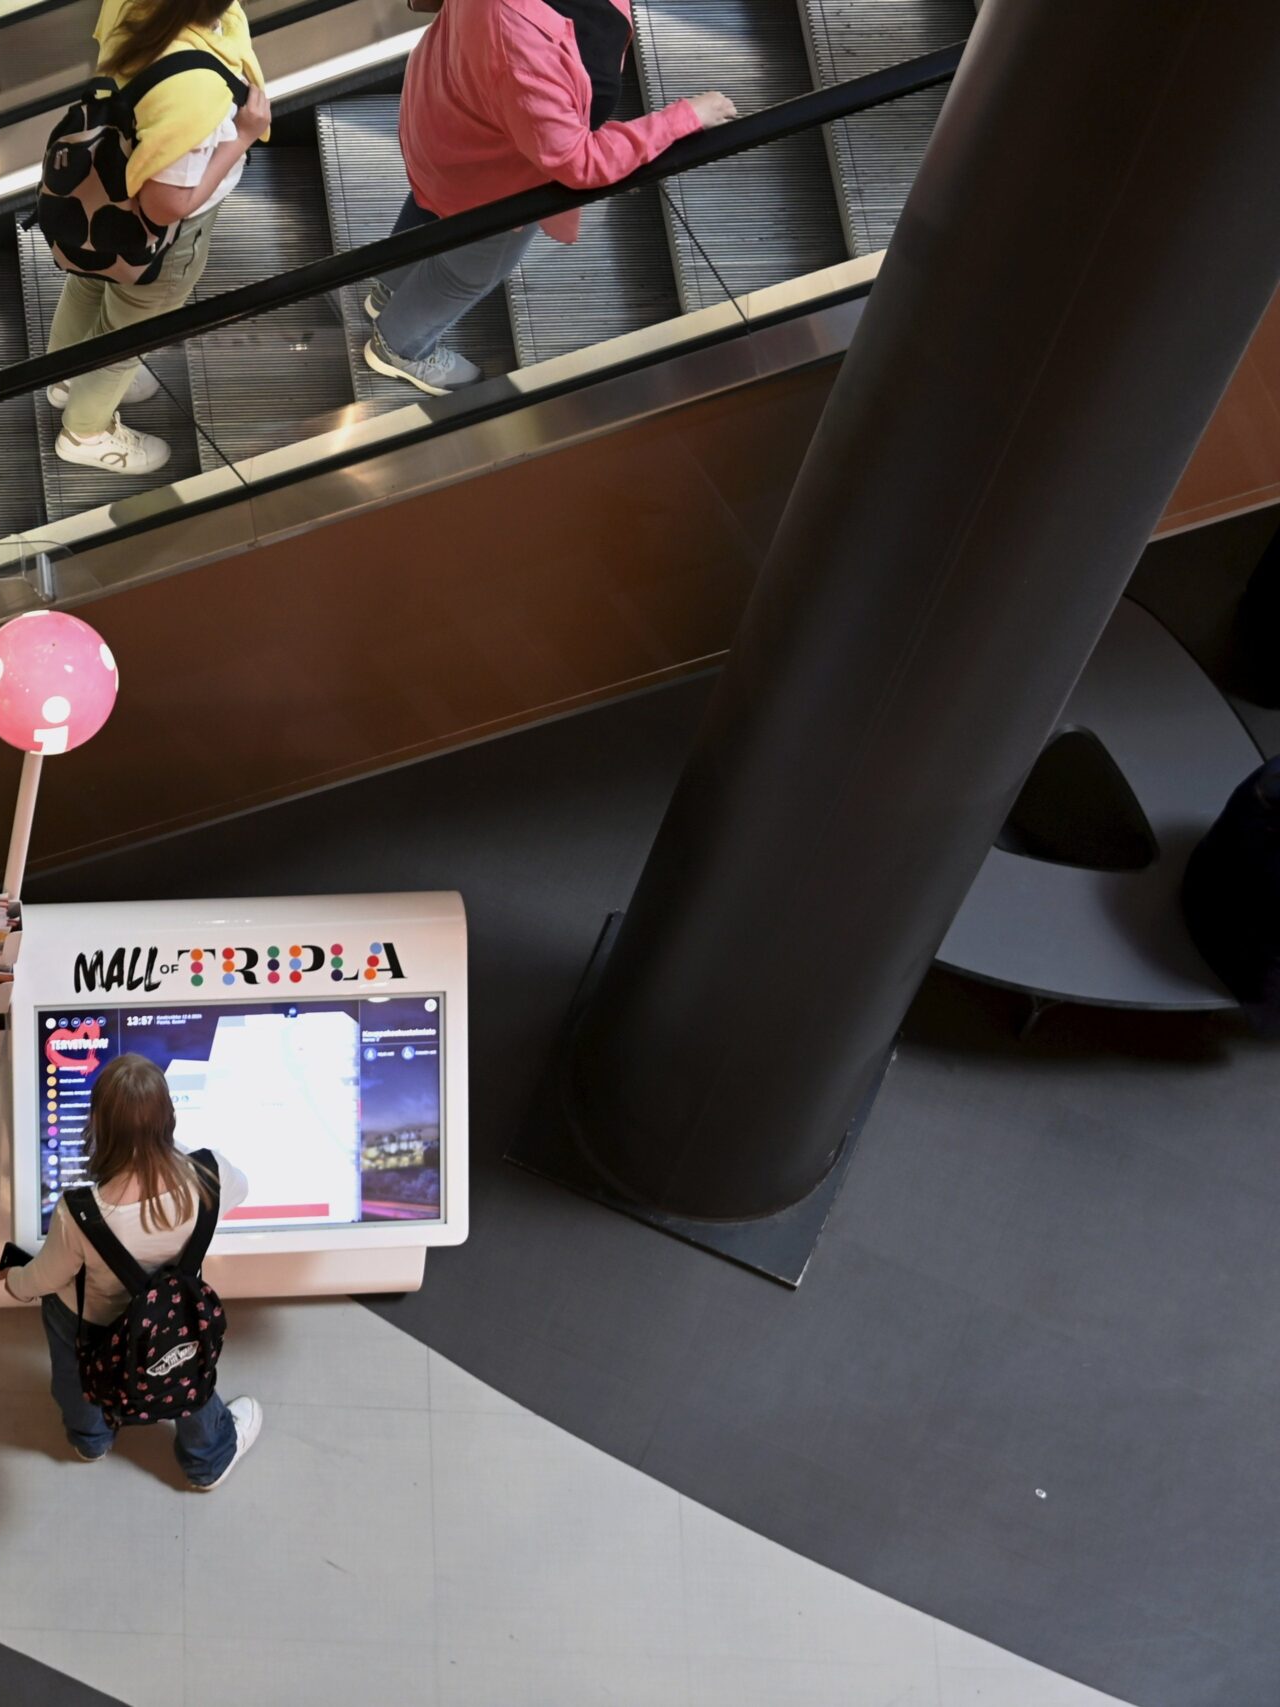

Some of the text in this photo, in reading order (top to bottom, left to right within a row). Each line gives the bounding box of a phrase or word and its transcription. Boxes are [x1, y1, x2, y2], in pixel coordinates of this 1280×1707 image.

[74, 942, 408, 993] MALL OF TRIPLA
